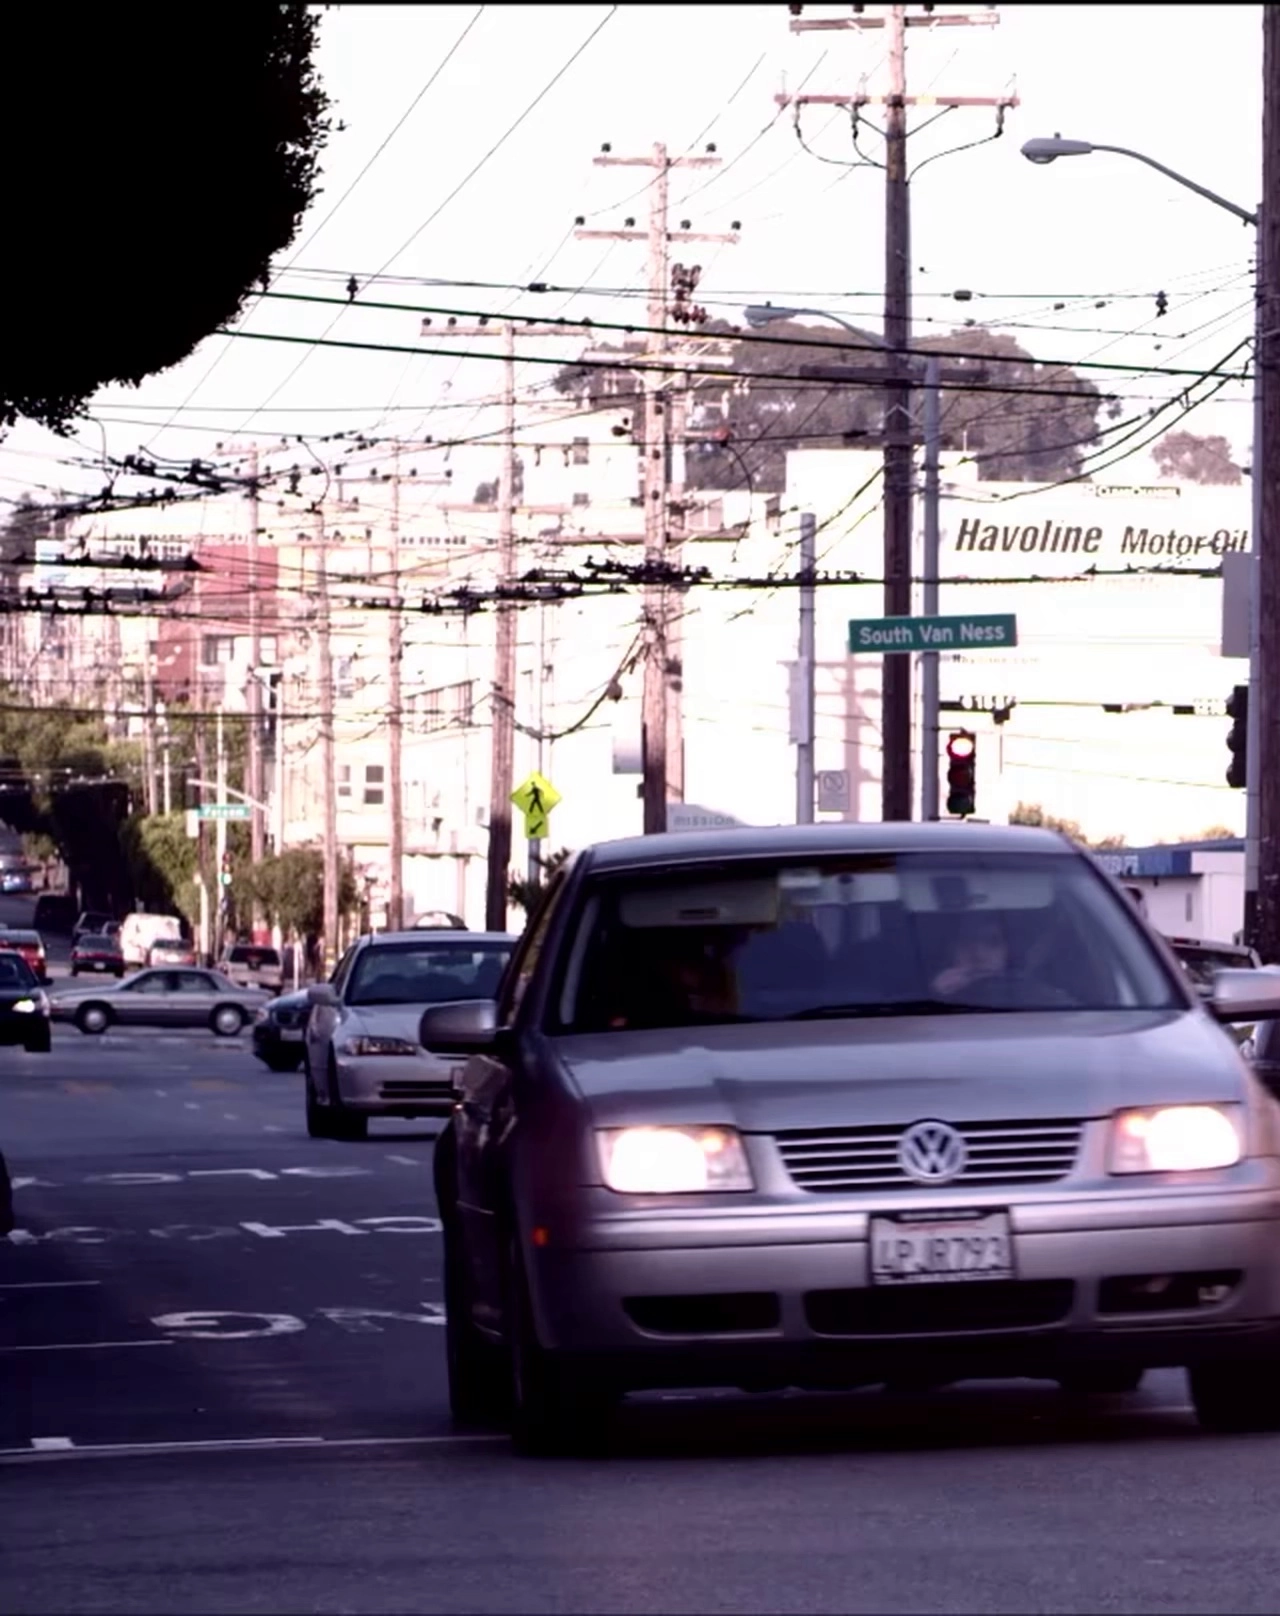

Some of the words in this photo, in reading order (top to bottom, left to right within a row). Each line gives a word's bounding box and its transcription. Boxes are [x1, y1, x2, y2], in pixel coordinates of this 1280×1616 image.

[955, 518, 1103, 554] Havoline
[1120, 526, 1208, 556] Motor
[859, 626, 913, 645] South
[919, 625, 953, 643] Van
[959, 623, 1006, 642] Ness
